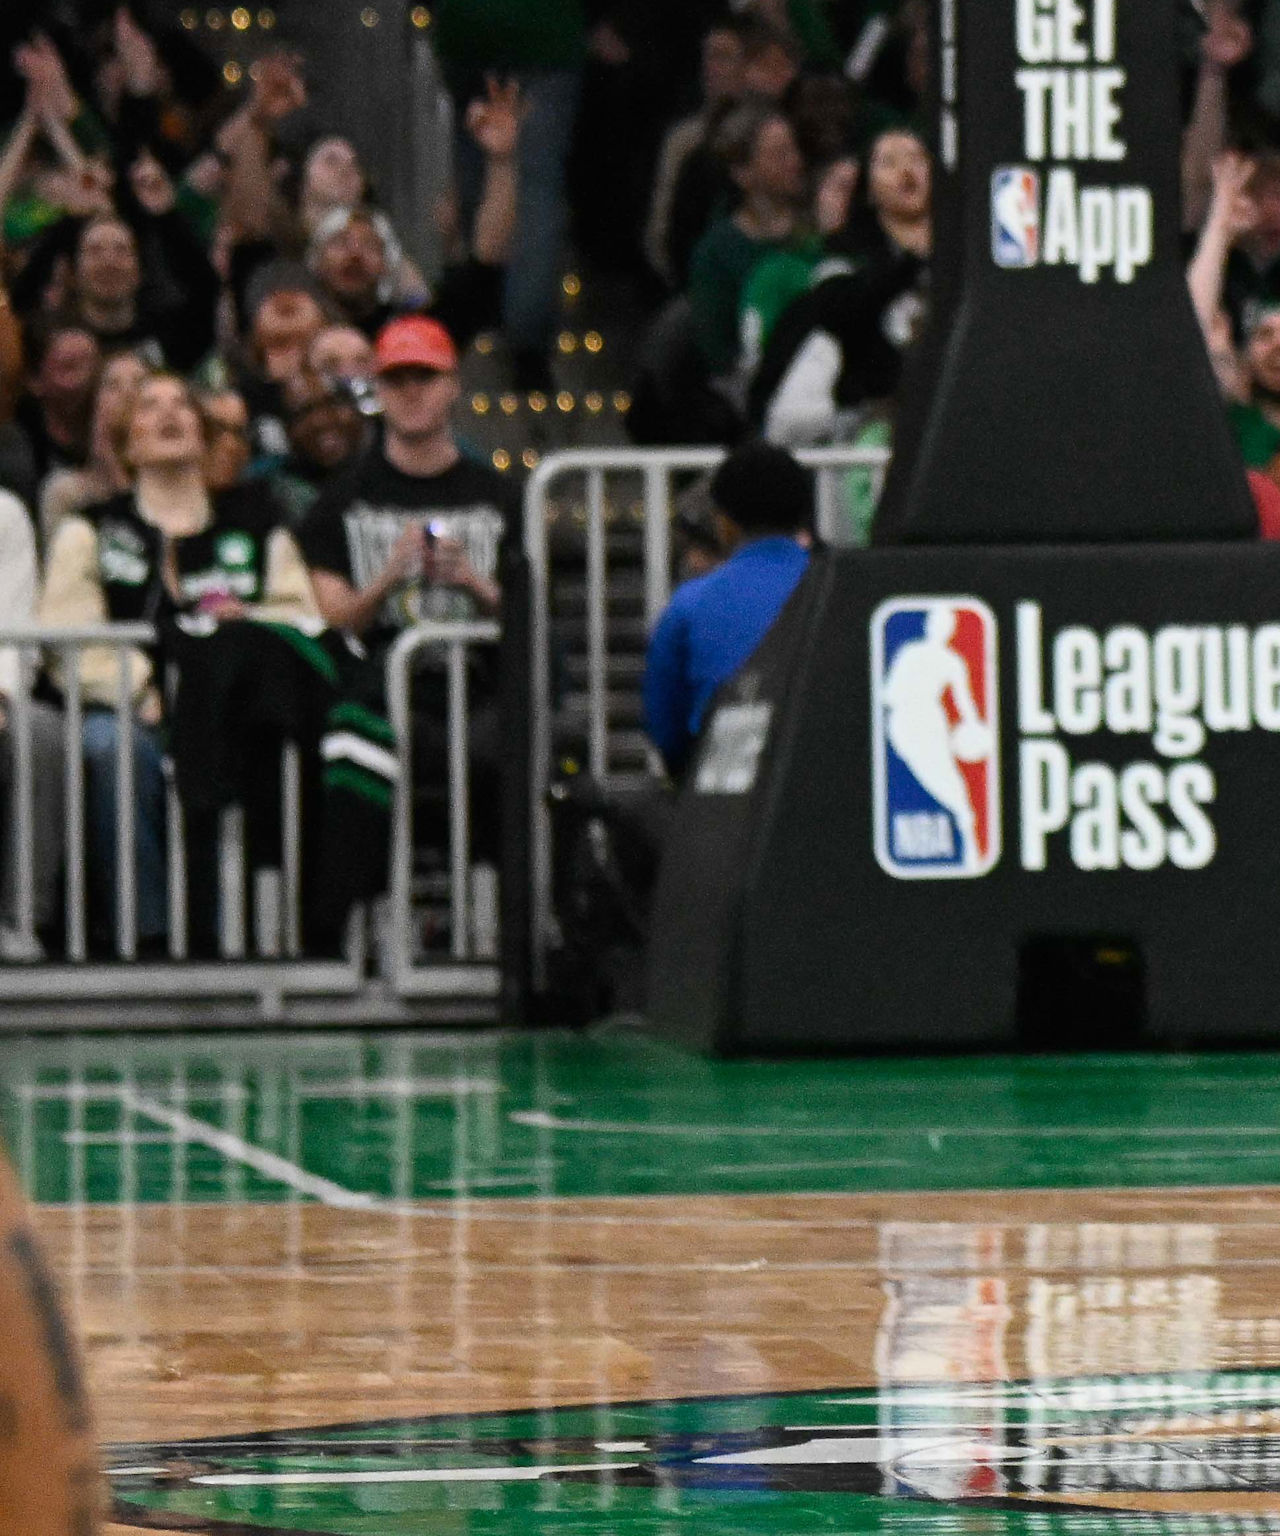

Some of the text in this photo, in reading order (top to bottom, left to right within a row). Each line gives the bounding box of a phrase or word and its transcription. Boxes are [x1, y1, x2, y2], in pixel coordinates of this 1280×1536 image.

[1014, 69, 1127, 162] THE
[1043, 166, 1153, 284] App
[1018, 737, 1217, 872] Pass
